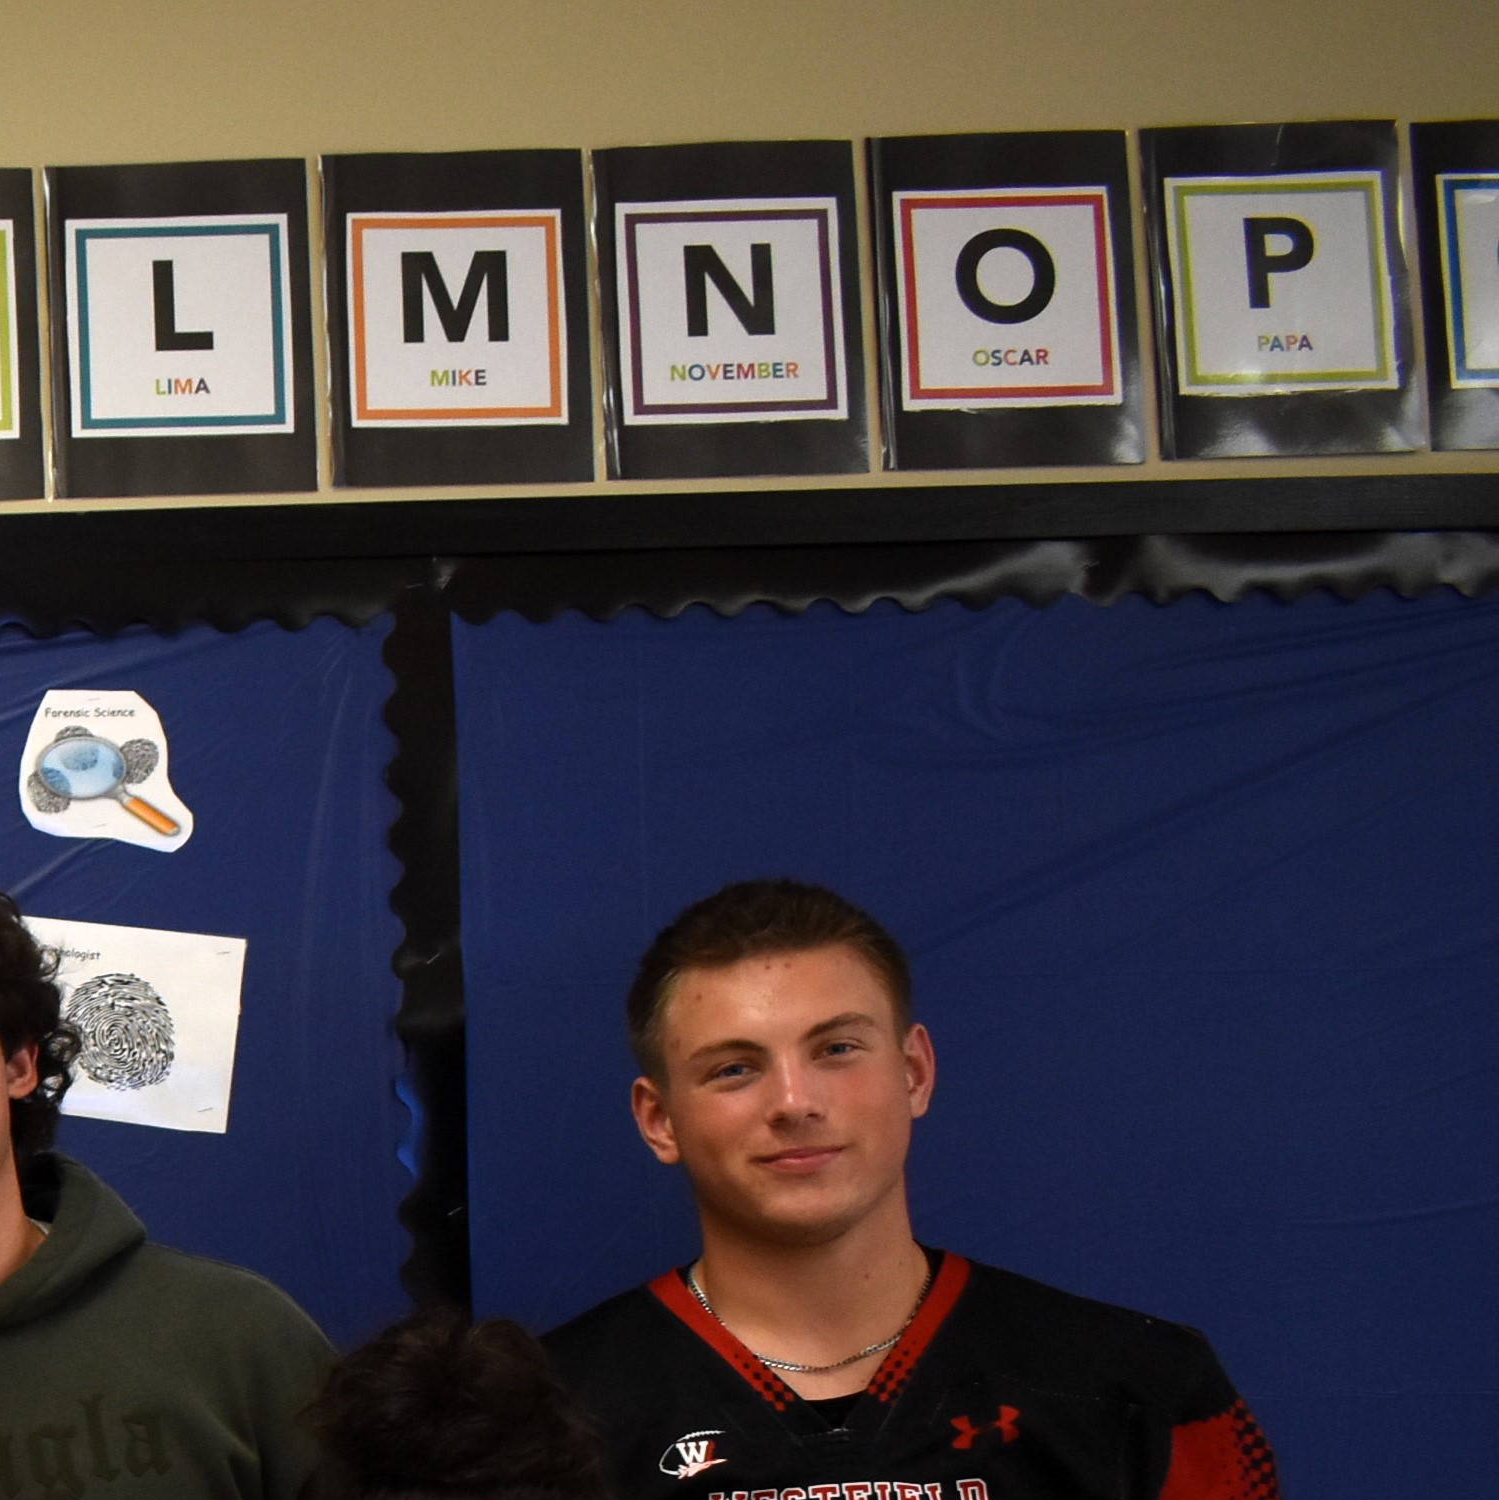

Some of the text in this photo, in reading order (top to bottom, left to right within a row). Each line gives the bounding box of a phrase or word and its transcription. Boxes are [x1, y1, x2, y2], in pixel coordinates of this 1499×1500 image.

[1243, 216, 1315, 309] P
[955, 227, 1057, 325] O
[401, 250, 509, 343] M
[683, 242, 776, 337] N
[151, 259, 214, 351] L
[1257, 334, 1313, 351] PAPA
[973, 348, 1049, 366] OSCAR
[430, 369, 487, 388] MIKE
[670, 361, 799, 381] NOVEMBER
[155, 377, 210, 396] LIMA
[44, 707, 135, 718] Forensic Science
